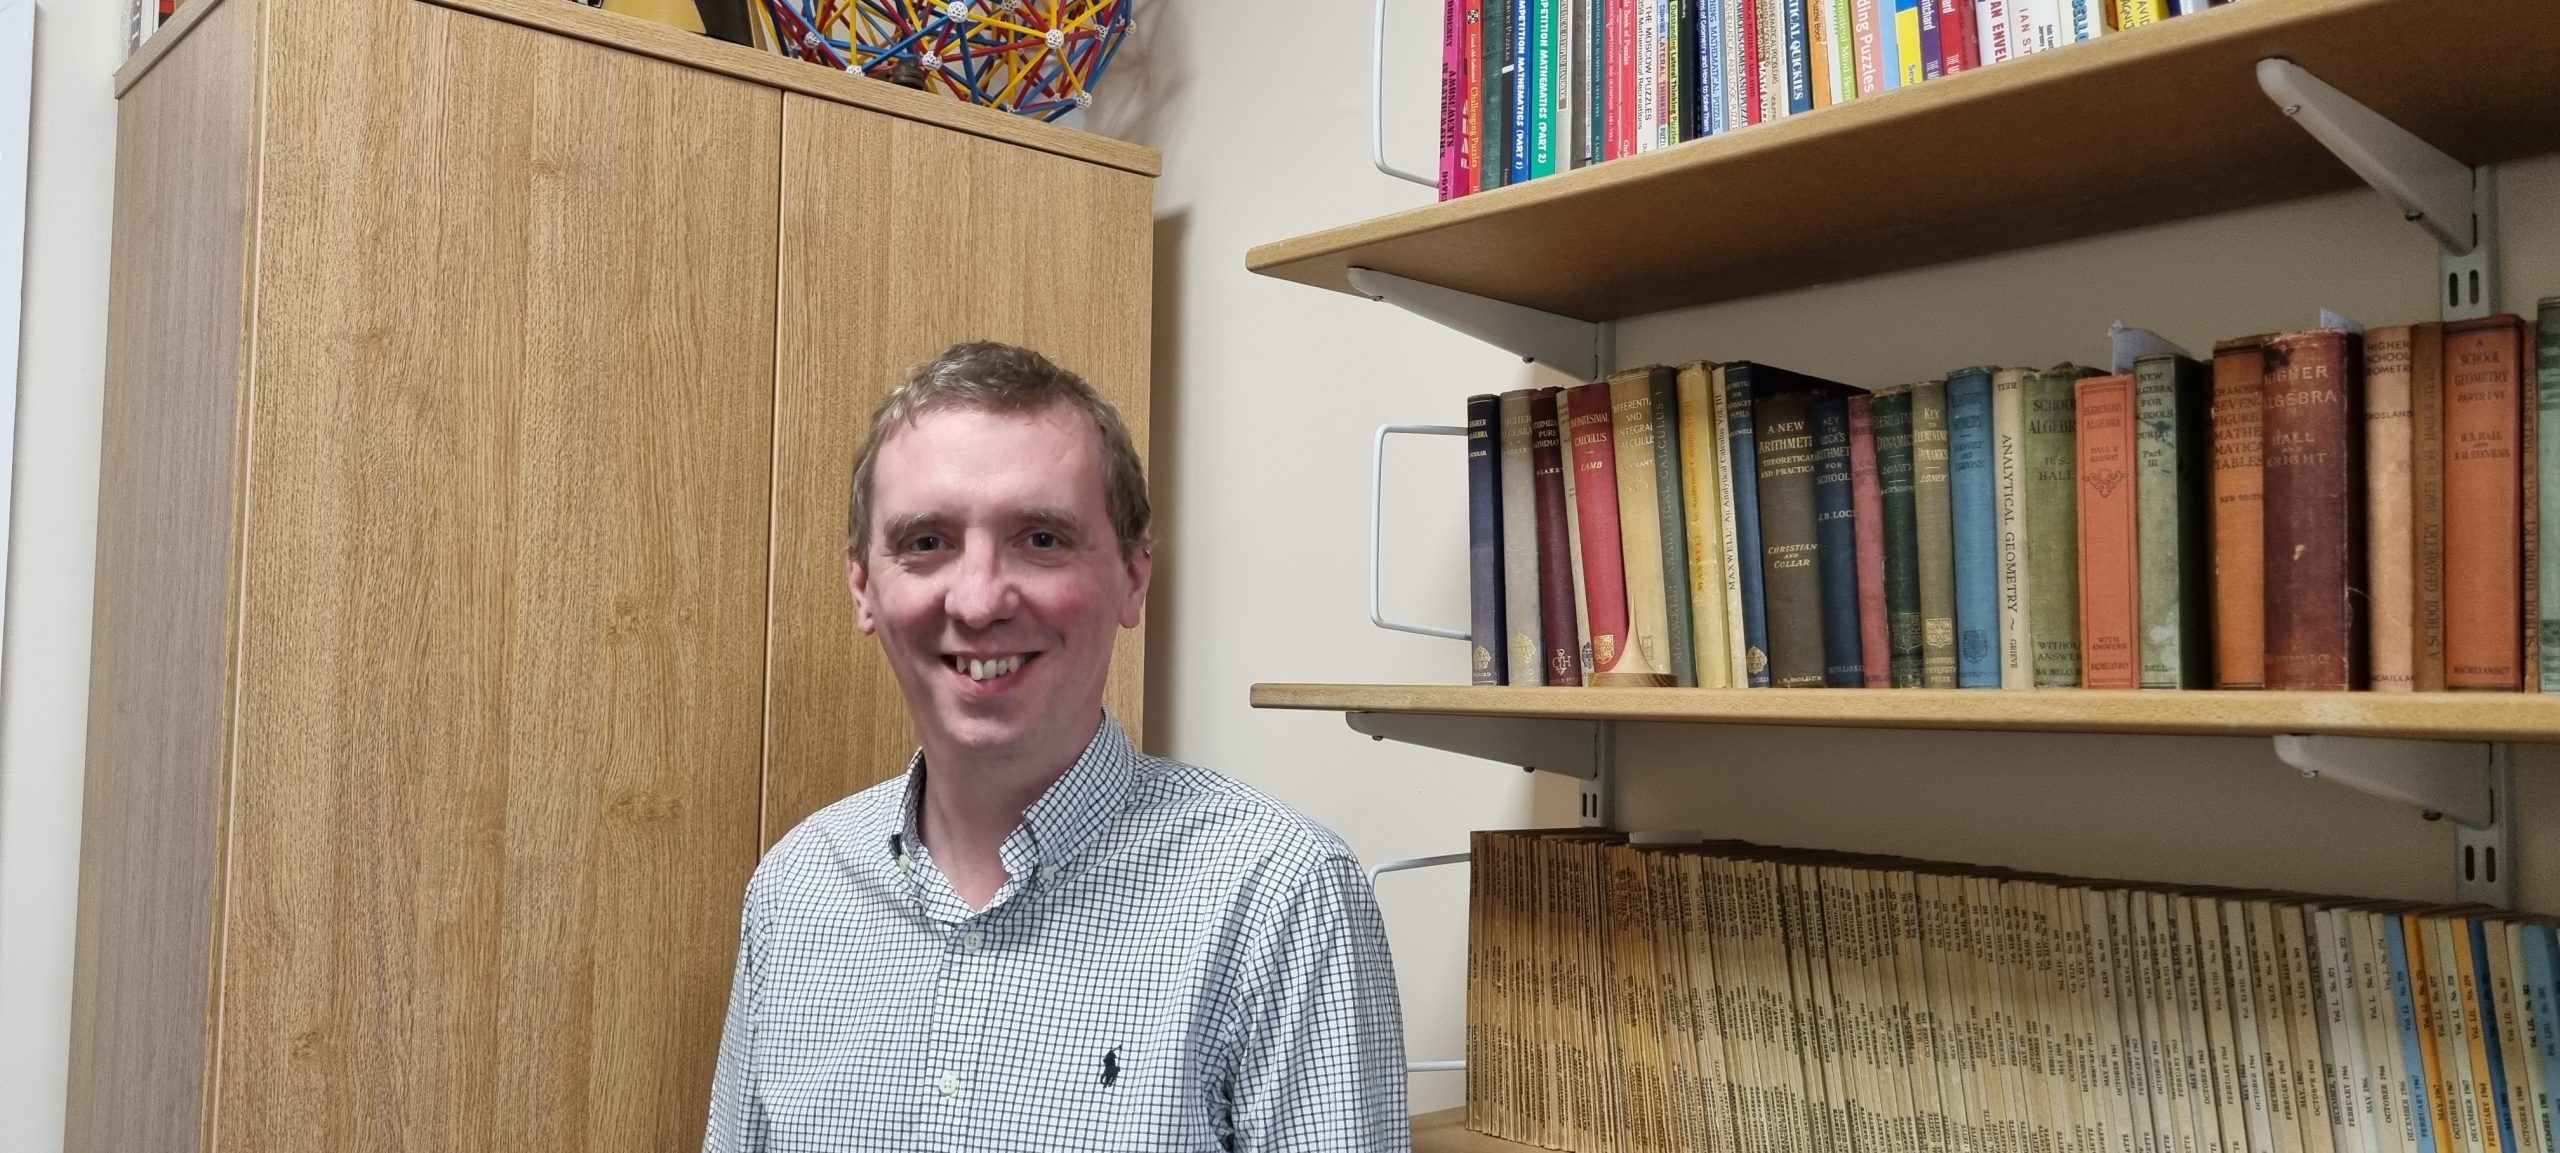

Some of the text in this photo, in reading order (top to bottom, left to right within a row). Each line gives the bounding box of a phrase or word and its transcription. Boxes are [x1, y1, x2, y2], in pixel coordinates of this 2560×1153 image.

[1669, 4, 1677, 51] Outstanding
[2019, 8, 2031, 33] IAN
[1659, 36, 1667, 77] LATERAL
[1737, 44, 1747, 75] GAMES
[1856, 0, 1876, 94] ding Puzzles
[1992, 22, 2008, 64] ENVEL
[1645, 4, 1653, 121] THE MOSCOW PUZZLES
[1758, 59, 1768, 93] MATH
[1789, 40, 1804, 100] QUICKIES
[1841, 46, 1852, 74] Mind
[1515, 57, 1526, 126] MATHEMATICS
[1537, 0, 1549, 164] PETITION MATHEMATICS (PART 2)
[1710, 26, 1721, 130] MATHEMATICAL PUZZLES
[1659, 80, 1667, 125] THINKING
[1669, 82, 1678, 114] Thinking
[1702, 95, 1710, 111] Solve
[1469, 86, 1481, 168] Challenging Puzzles
[1670, 116, 1678, 145] Puzzles
[1703, 112, 1711, 132] Them
[1515, 129, 1525, 158] (PART
[2140, 372, 2164, 383] NEW
[2264, 365, 2329, 386] HIGHER
[1715, 394, 1723, 405] III
[1716, 407, 1725, 425] Vol.
[1923, 406, 1941, 420] KEY
[2140, 398, 2163, 408] FOR
[2267, 389, 2338, 410] LGEBRA
[1767, 420, 1805, 435] A NEW
[1822, 416, 1840, 427] KEY
[1574, 432, 1608, 447] CALCULUS
[1655, 402, 1670, 480] CALCULUS
[1718, 427, 1728, 463] Calculus
[2272, 431, 2315, 447] HALL
[1580, 460, 1604, 473] LAMB
[1760, 469, 1774, 480] AND
[1825, 461, 1843, 470] FOR
[2266, 451, 2329, 468] KNIGHT
[1721, 465, 1732, 508] Analytical
[1918, 473, 1949, 483] LONEY
[1724, 509, 1732, 523] An
[1767, 543, 1818, 556] CHRISTIAN
[1773, 557, 1811, 569] COLLAR
[2002, 433, 2019, 669] ANALYTICAL GEOMETRY GRIEVE
[2424, 521, 2441, 662] A SCHOOL GEOMETRY
[2250, 1072, 2262, 1111] OCTOBER
[2280, 1077, 2293, 1120] FEBRUARY
[2341, 1065, 2356, 1128] FEBRUARY 1966
[2361, 1076, 2374, 1114] MAY 1966
[2380, 1083, 2393, 1124] OCTOBER
[2412, 1074, 2428, 1138] FEBRUARY 1967
[2398, 1080, 2415, 1142] DECEMBER 1966
[2436, 1102, 2446, 1121] MAY
[2448, 1098, 2461, 1140] OCTOBER
[2462, 1079, 2479, 1143] DECEMBER 1967
[2483, 1101, 2497, 1148] FEBRUARY
[2517, 1105, 2531, 1147] OCTOBER
